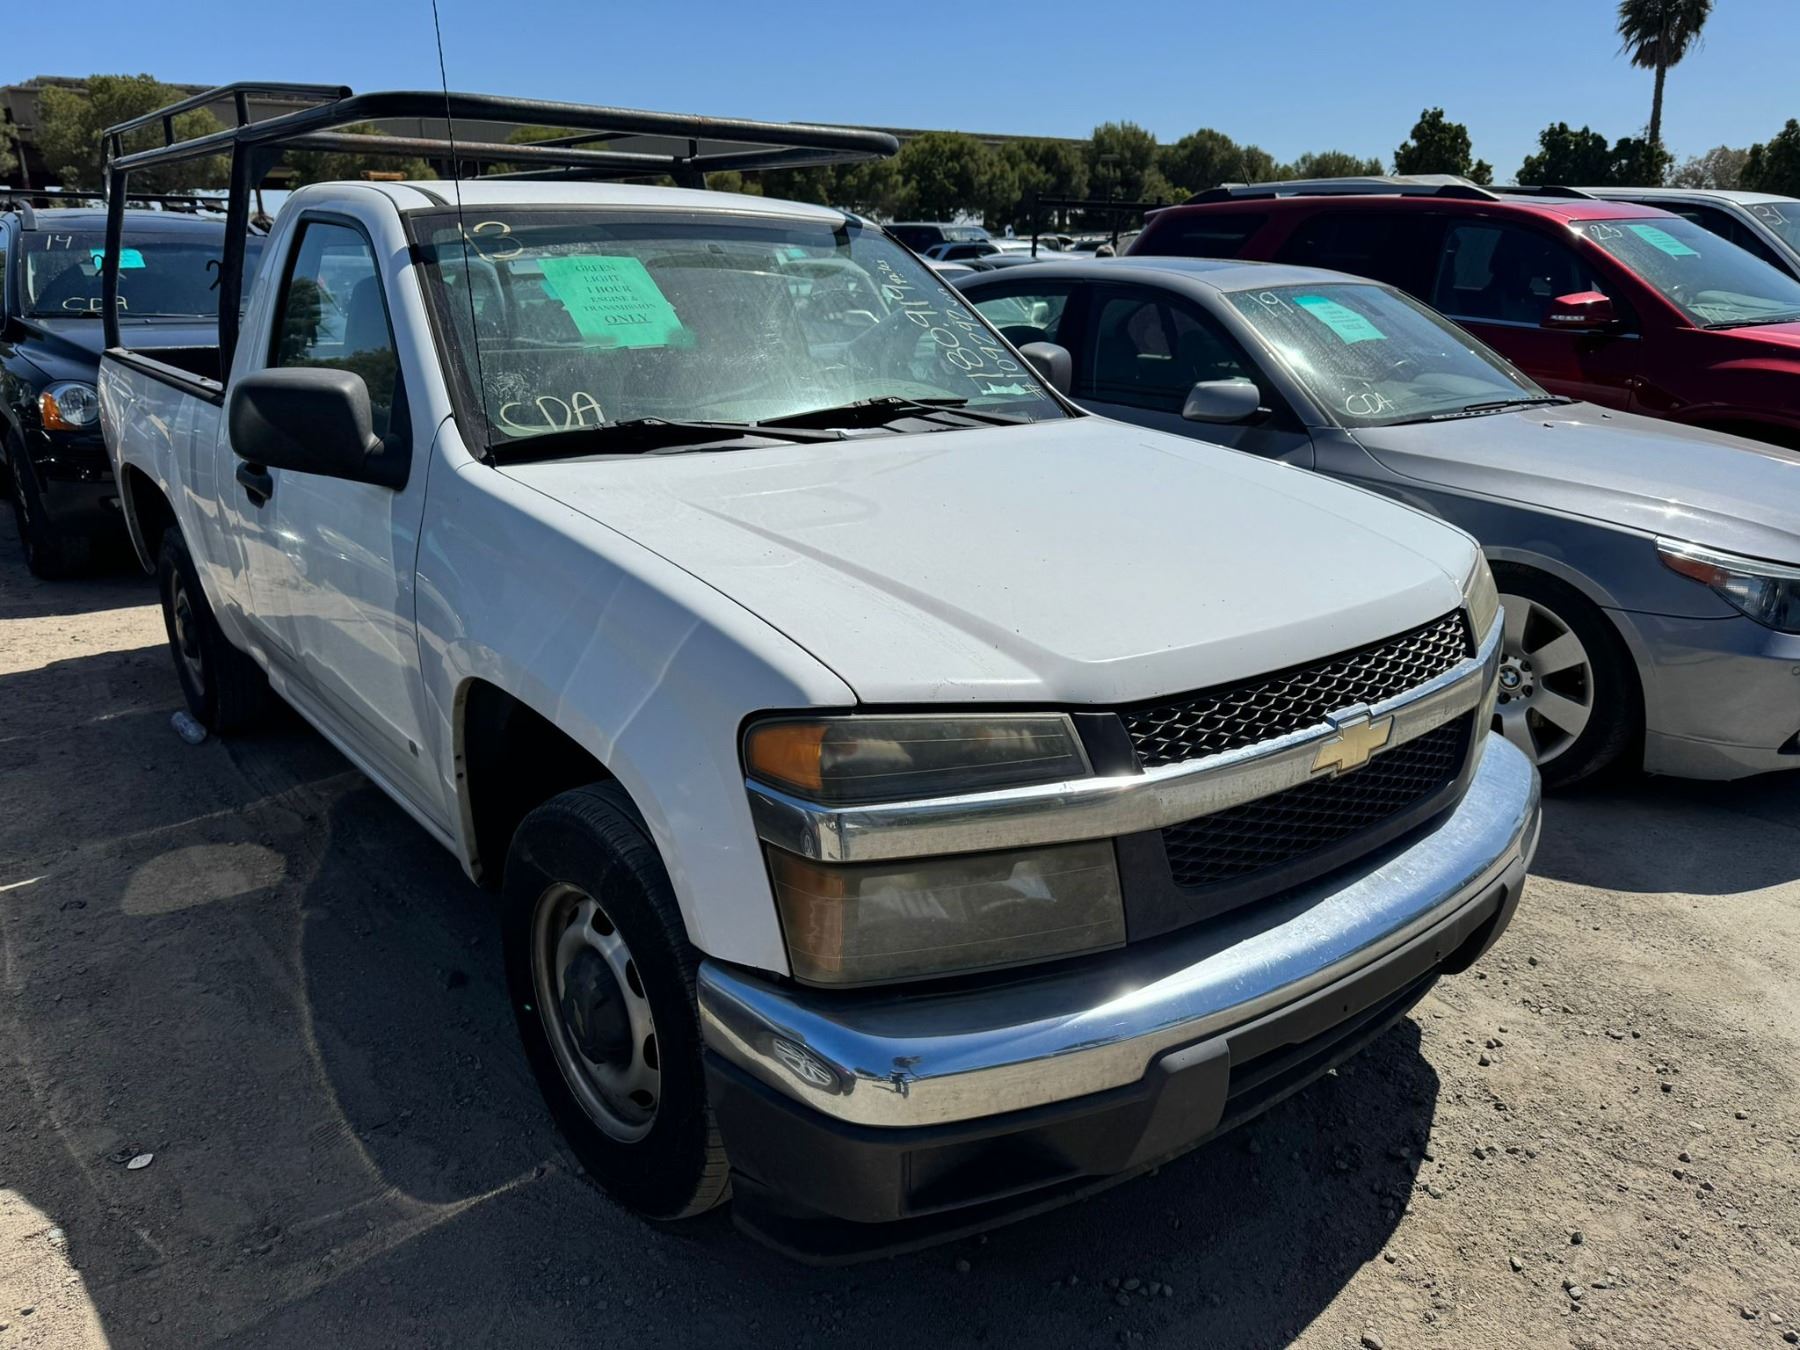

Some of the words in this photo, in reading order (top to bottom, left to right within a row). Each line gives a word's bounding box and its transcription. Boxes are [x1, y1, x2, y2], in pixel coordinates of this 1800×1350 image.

[46, 234, 73, 250] 14
[575, 264, 617, 272] GREEN
[584, 274, 620, 283] LIGHT
[586, 285, 592, 294] 1
[594, 284, 632, 293] HOUR
[590, 295, 627, 303] ENGINE
[1246, 291, 1294, 317] 19
[604, 313, 648, 325] ONLY
[1345, 392, 1395, 415] CDA
[500, 391, 607, 433] CDA
